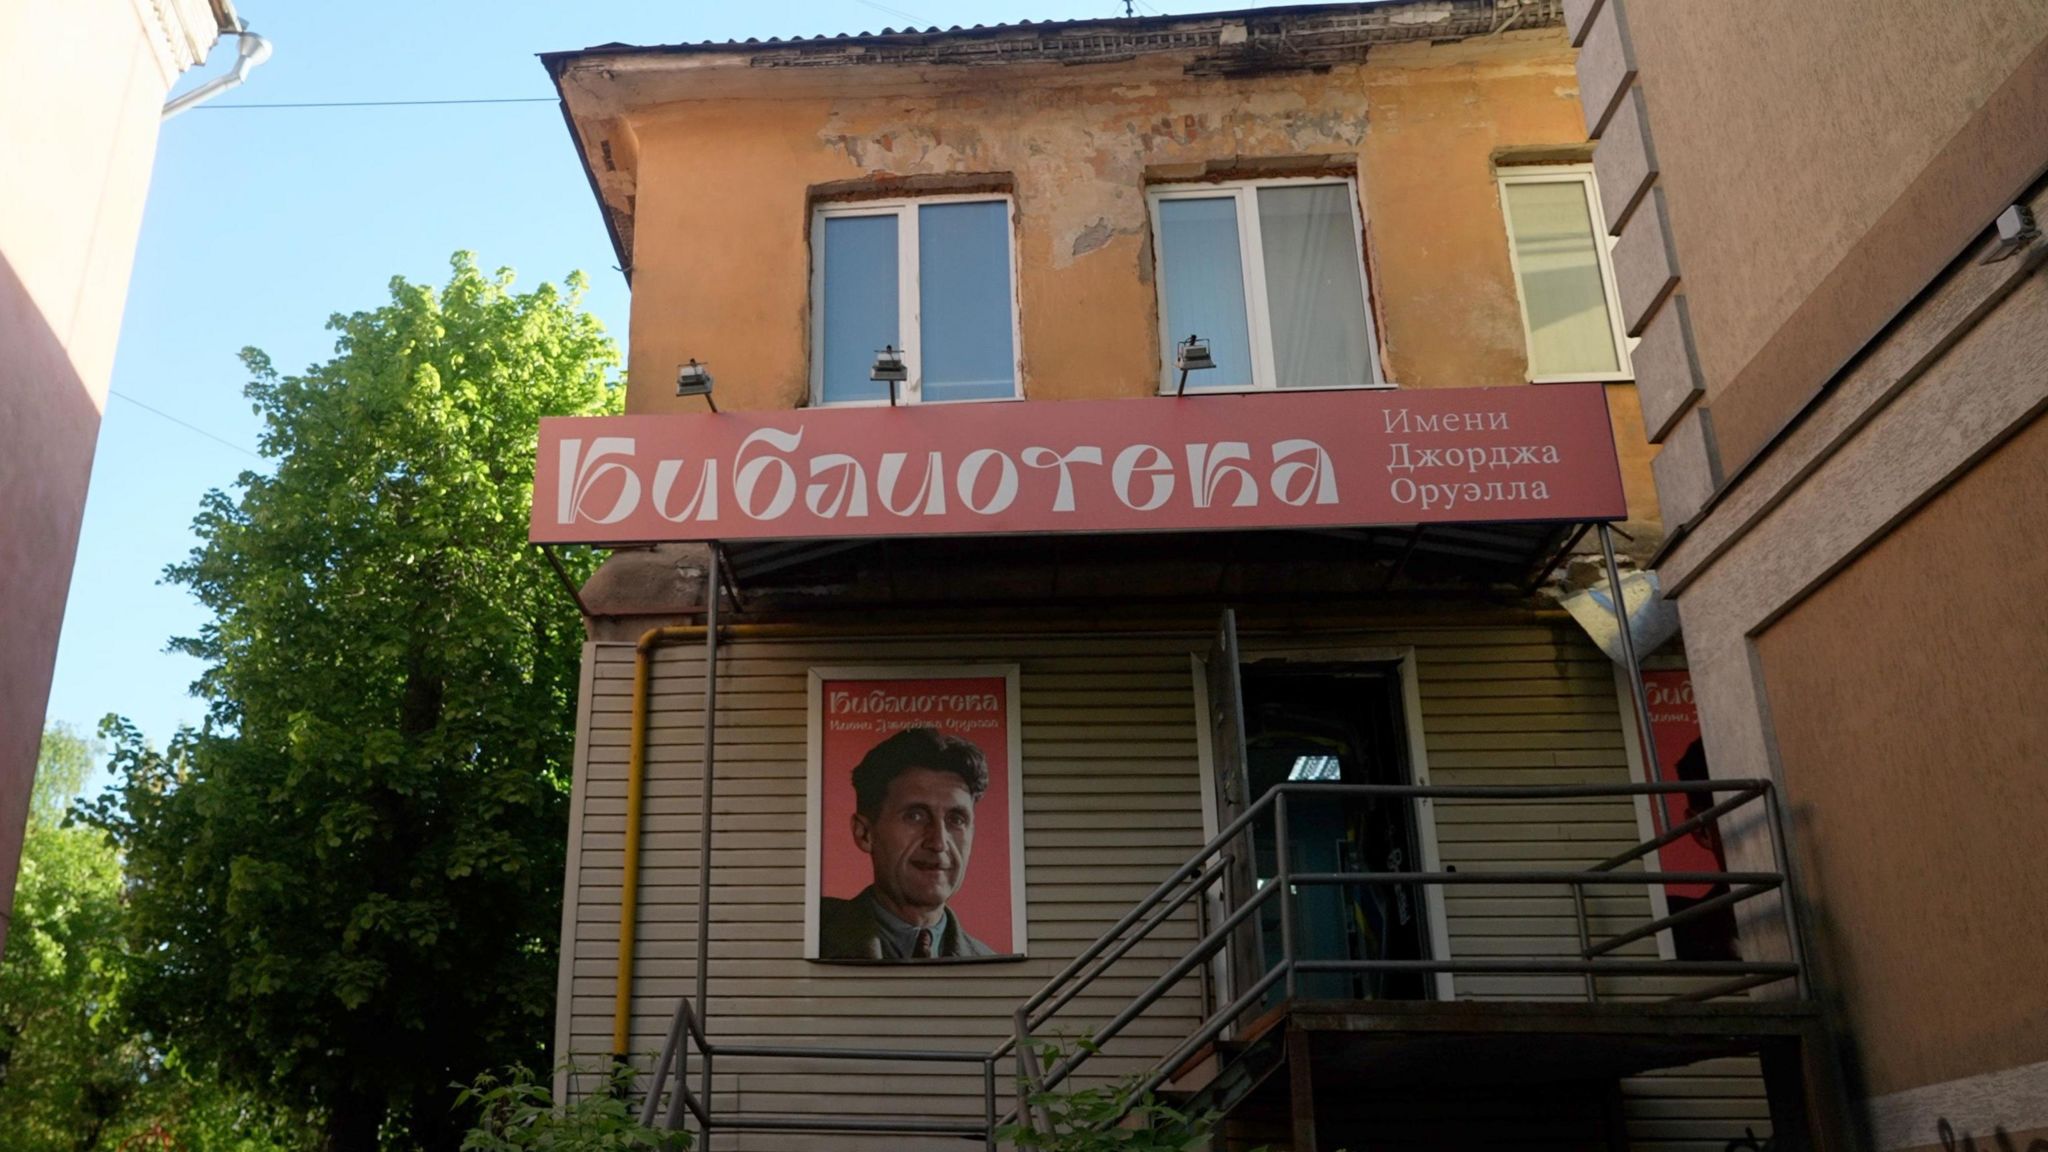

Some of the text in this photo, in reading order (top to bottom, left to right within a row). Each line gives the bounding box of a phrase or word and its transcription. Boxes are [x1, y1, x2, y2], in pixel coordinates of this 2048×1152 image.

[1382, 408, 1510, 434] Имени
[1387, 440, 1560, 474] Джорджа
[557, 425, 1340, 525] Библиотека
[1390, 476, 1551, 510] Оруэлла
[829, 690, 999, 714] Библиотека
